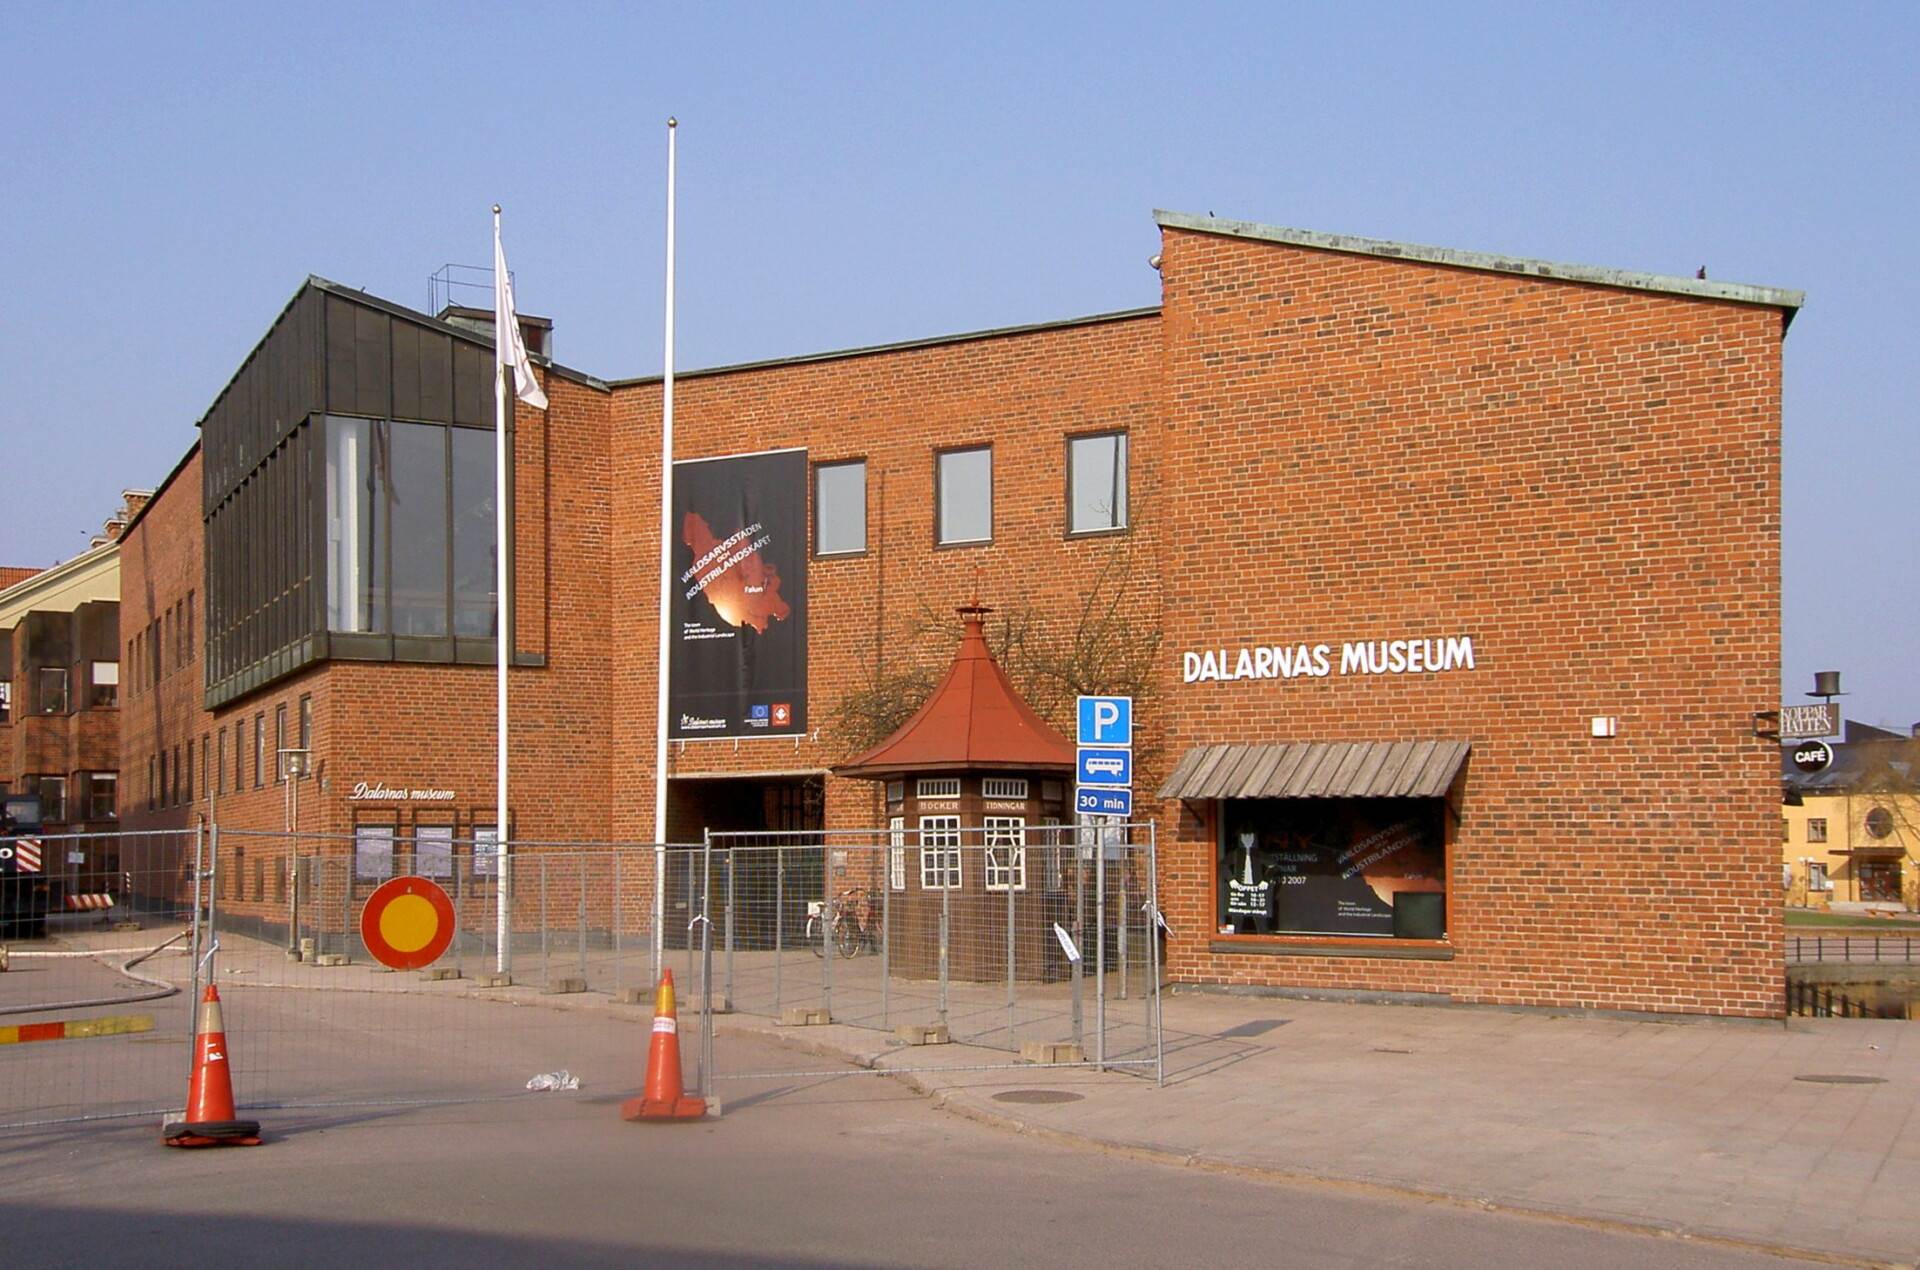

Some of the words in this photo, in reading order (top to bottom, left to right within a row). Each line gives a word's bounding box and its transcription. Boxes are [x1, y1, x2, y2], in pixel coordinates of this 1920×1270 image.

[684, 534, 772, 600] INDUSTRILANDSKAPET
[744, 585, 764, 593] Falun
[1184, 644, 1331, 683] DALARNAS
[1340, 636, 1475, 675] MUSEUM
[1094, 701, 1119, 740] P
[1780, 718, 1831, 733] HATTEN
[1795, 748, 1826, 763] CAFÉ
[349, 782, 408, 801] Dalarnas
[411, 788, 455, 801] museum
[986, 802, 1026, 811] TIDNINGAR
[1080, 796, 1098, 808] 30
[1103, 797, 1125, 810] min
[1287, 876, 1307, 885] 2007
